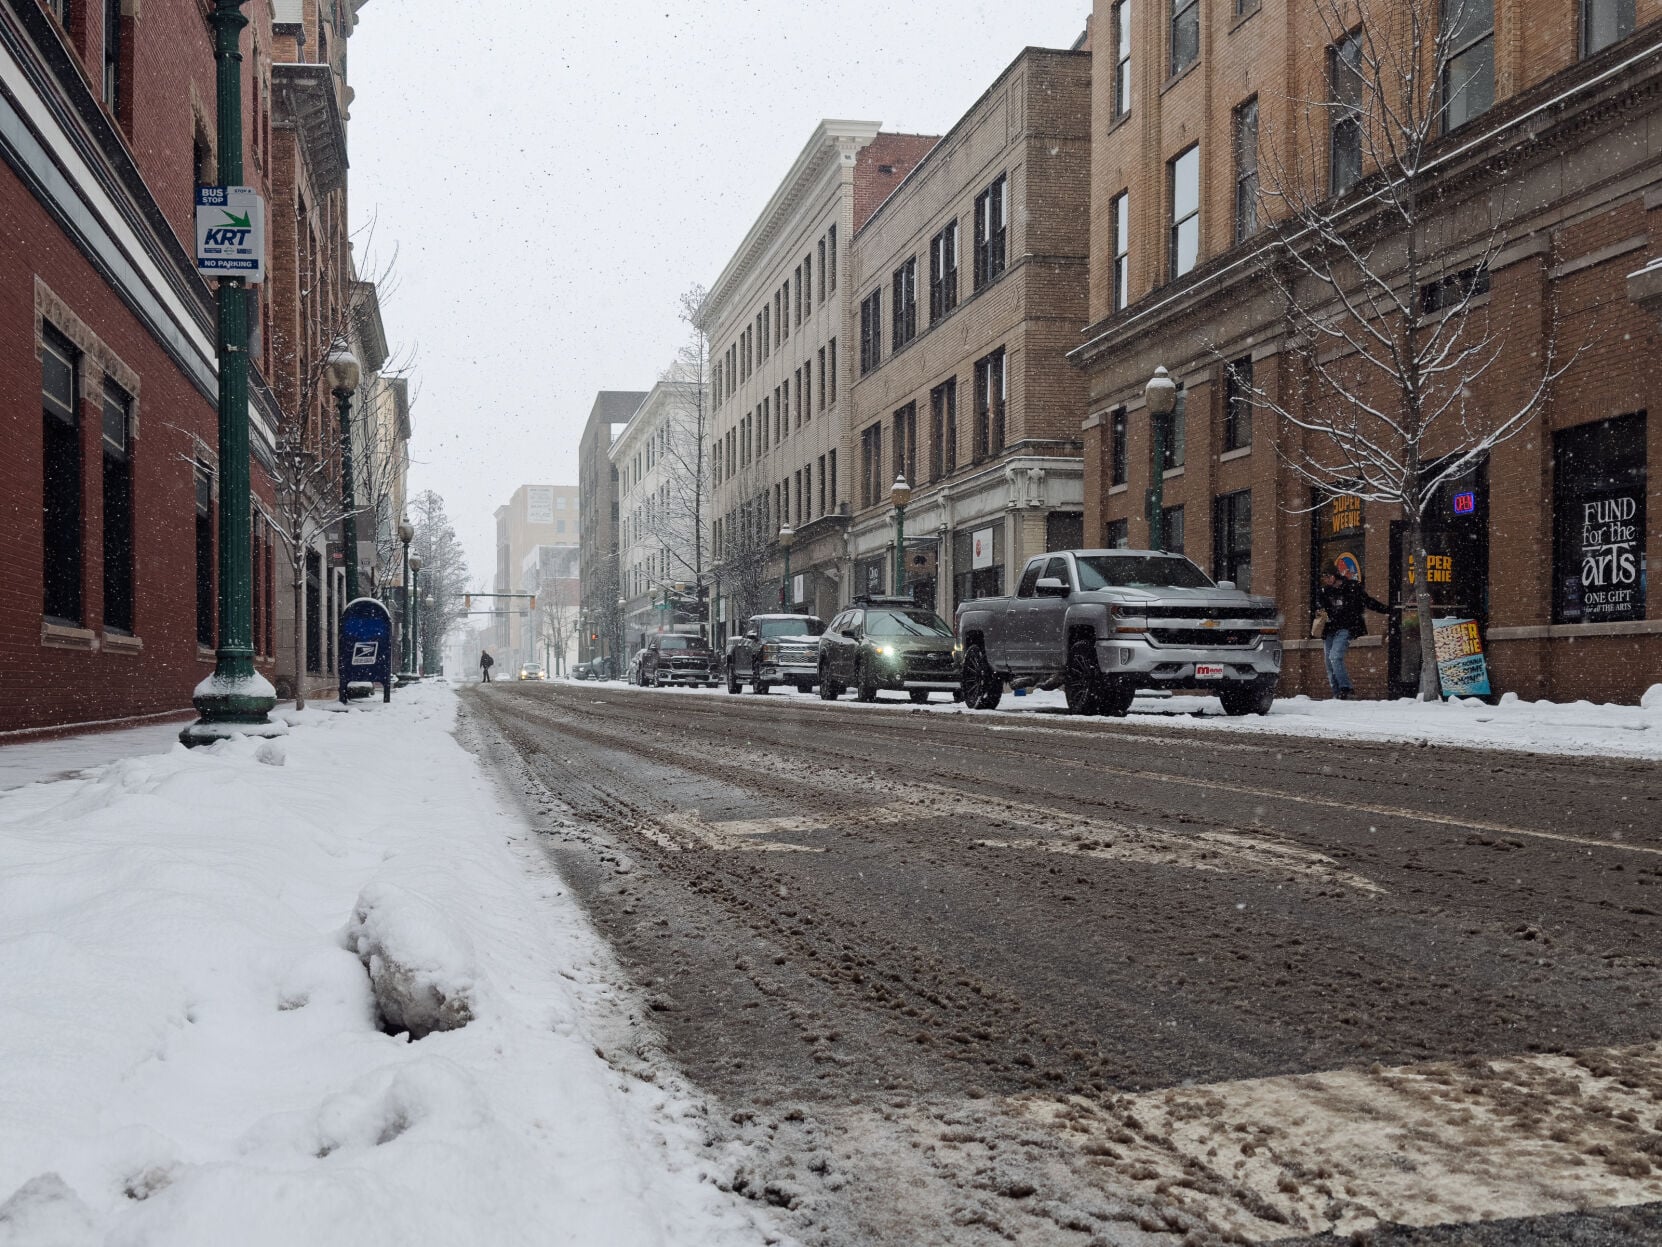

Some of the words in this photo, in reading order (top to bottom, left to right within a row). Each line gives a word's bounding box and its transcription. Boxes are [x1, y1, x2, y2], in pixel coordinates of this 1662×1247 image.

[202, 188, 223, 197] BUS
[204, 228, 251, 245] KRT
[1333, 495, 1360, 513] SUPER
[1454, 495, 1473, 511] OPEN
[1582, 497, 1636, 525] FUND
[1333, 511, 1360, 532] WEENIE
[1582, 523, 1607, 545] for
[1610, 521, 1636, 542] the
[1585, 591, 1607, 604] ONE
[1608, 589, 1632, 602] GIFT
